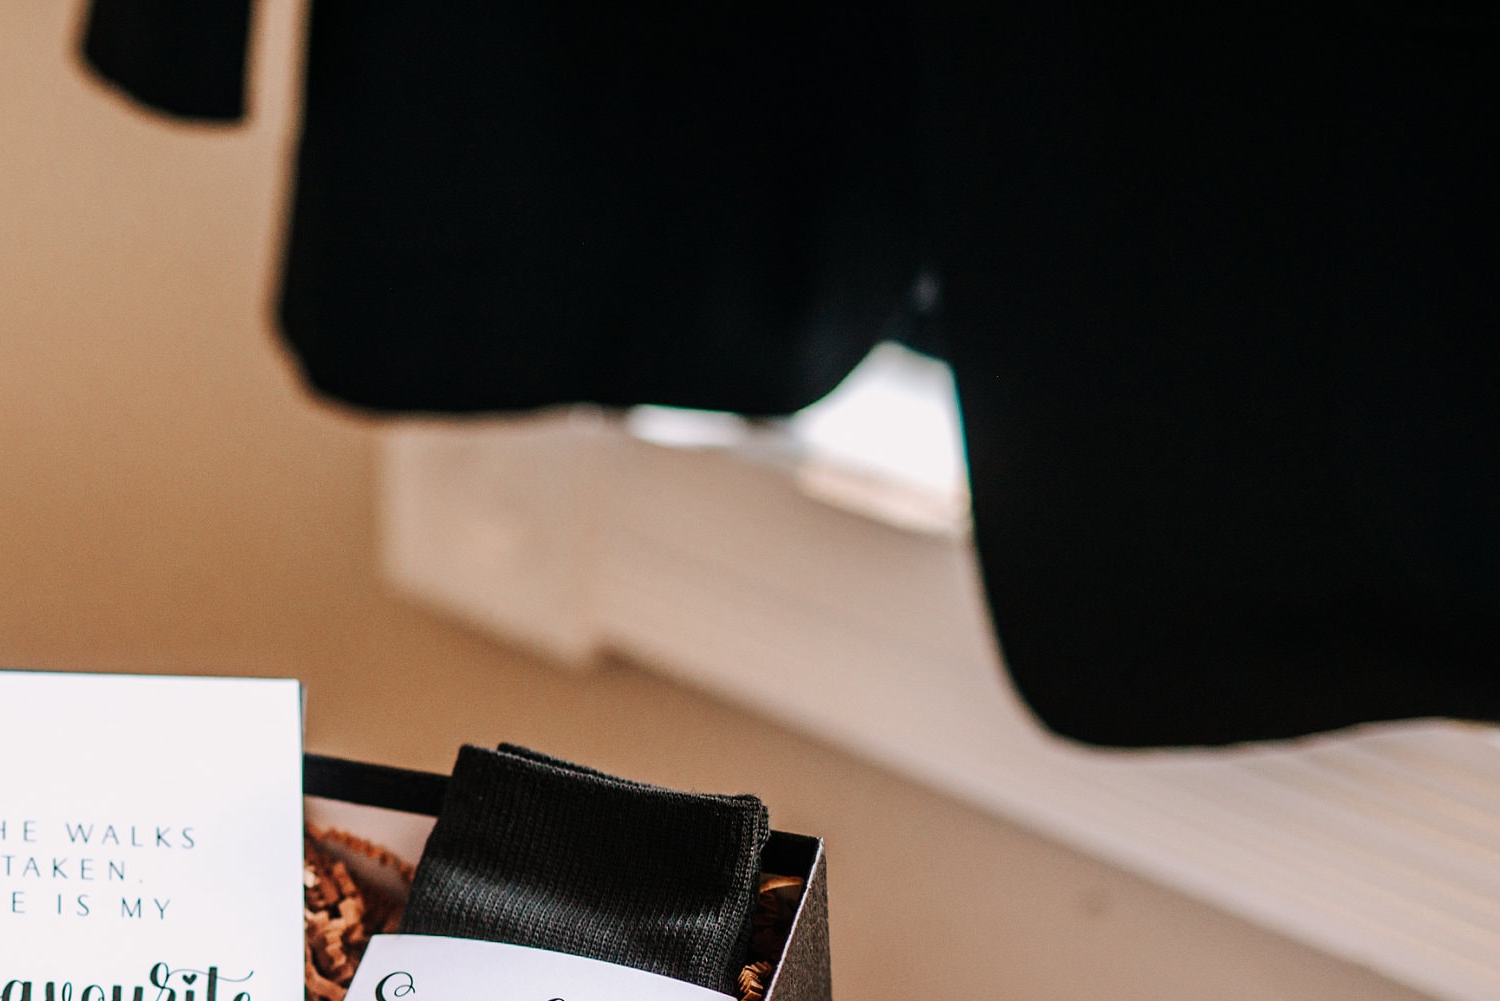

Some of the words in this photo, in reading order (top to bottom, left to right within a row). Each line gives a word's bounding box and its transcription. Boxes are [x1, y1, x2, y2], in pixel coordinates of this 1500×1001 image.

[65, 823, 197, 850] WALKS
[57, 893, 91, 917] IS
[120, 897, 172, 920] MY
